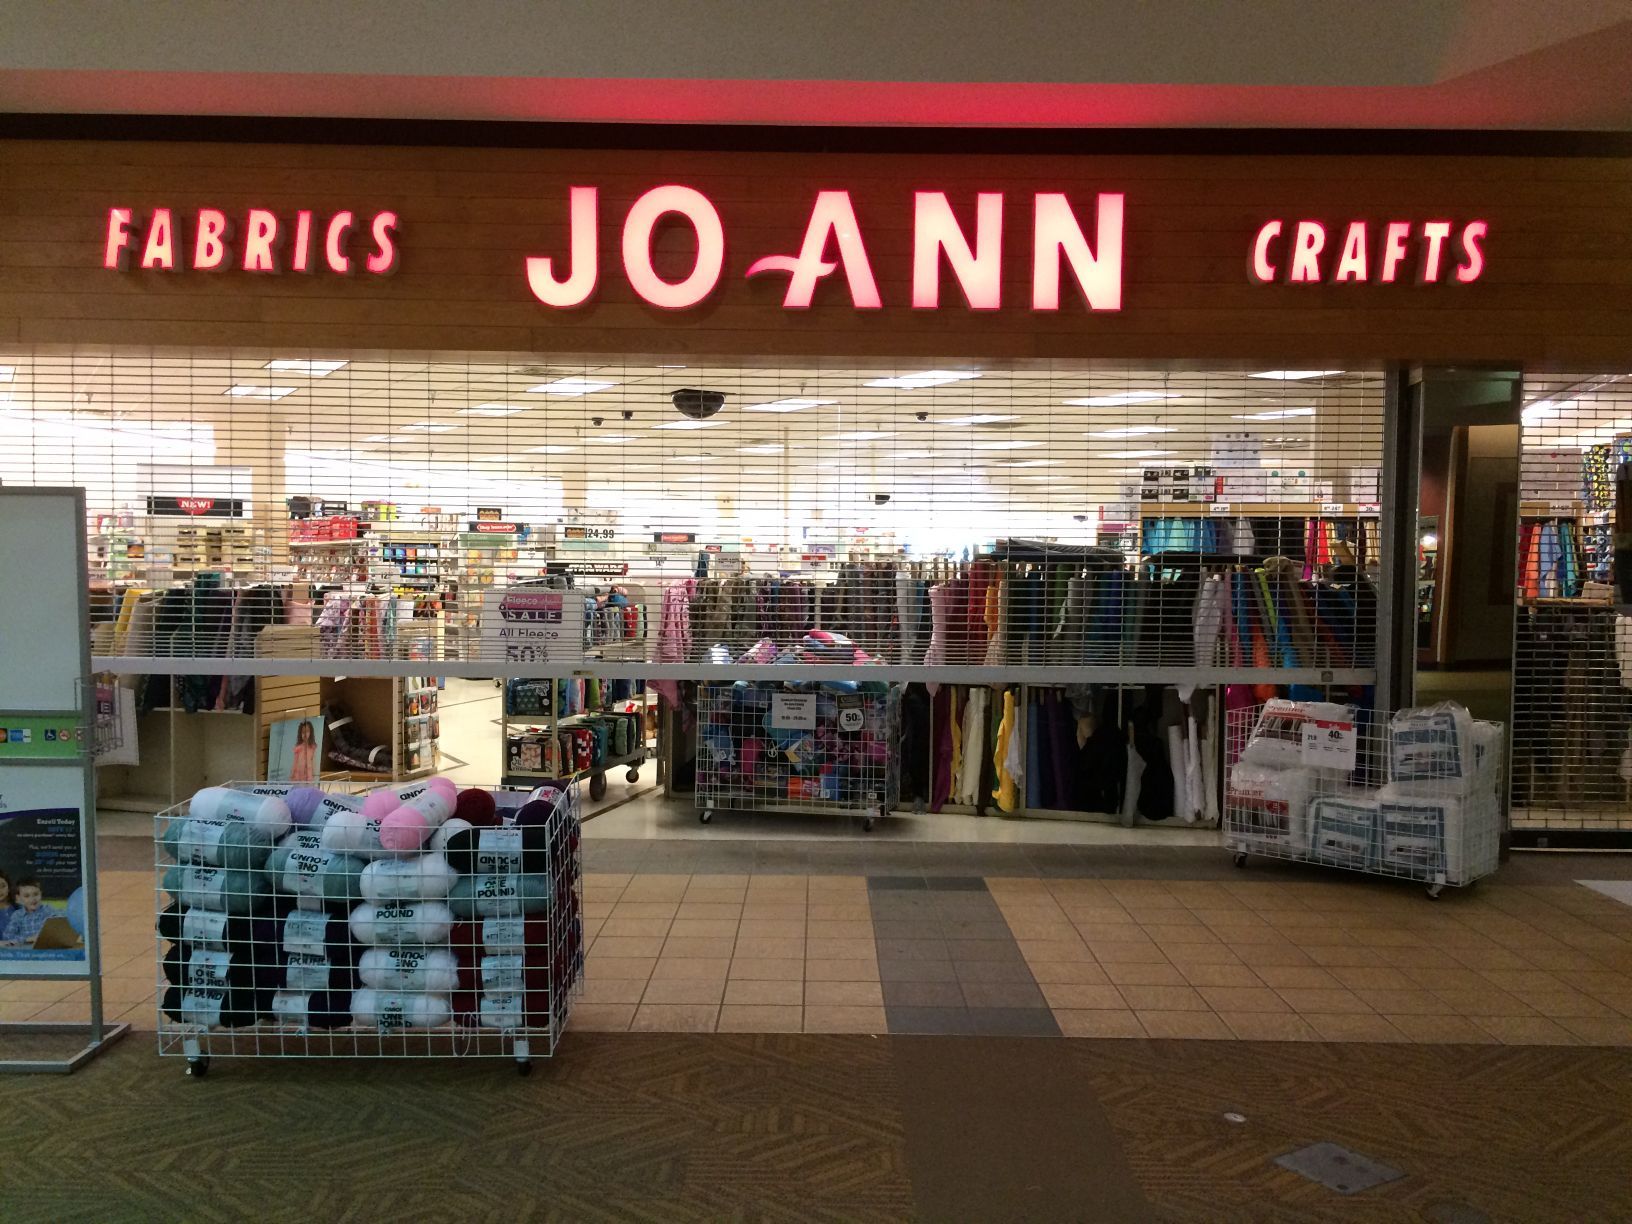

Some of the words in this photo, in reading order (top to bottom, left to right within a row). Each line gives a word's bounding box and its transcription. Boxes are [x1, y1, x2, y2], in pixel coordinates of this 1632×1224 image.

[104, 208, 397, 273] FABRICS
[1252, 220, 1484, 282] CRAFTS
[181, 500, 211, 509] NEW!
[587, 528, 615, 539] 24.99
[565, 564, 594, 573] STAR
[594, 564, 624, 573] WARS
[507, 611, 557, 620] SALE
[500, 628, 513, 637] All
[519, 628, 558, 639] Fleece
[1328, 730, 1340, 740] 40
[253, 788, 289, 797] POUND
[57, 818, 76, 826] Today
[290, 853, 329, 866] POUND
[299, 862, 319, 873] ONE
[477, 887, 515, 898] POUND
[376, 910, 414, 919] POUND
[195, 970, 216, 979] ONE
